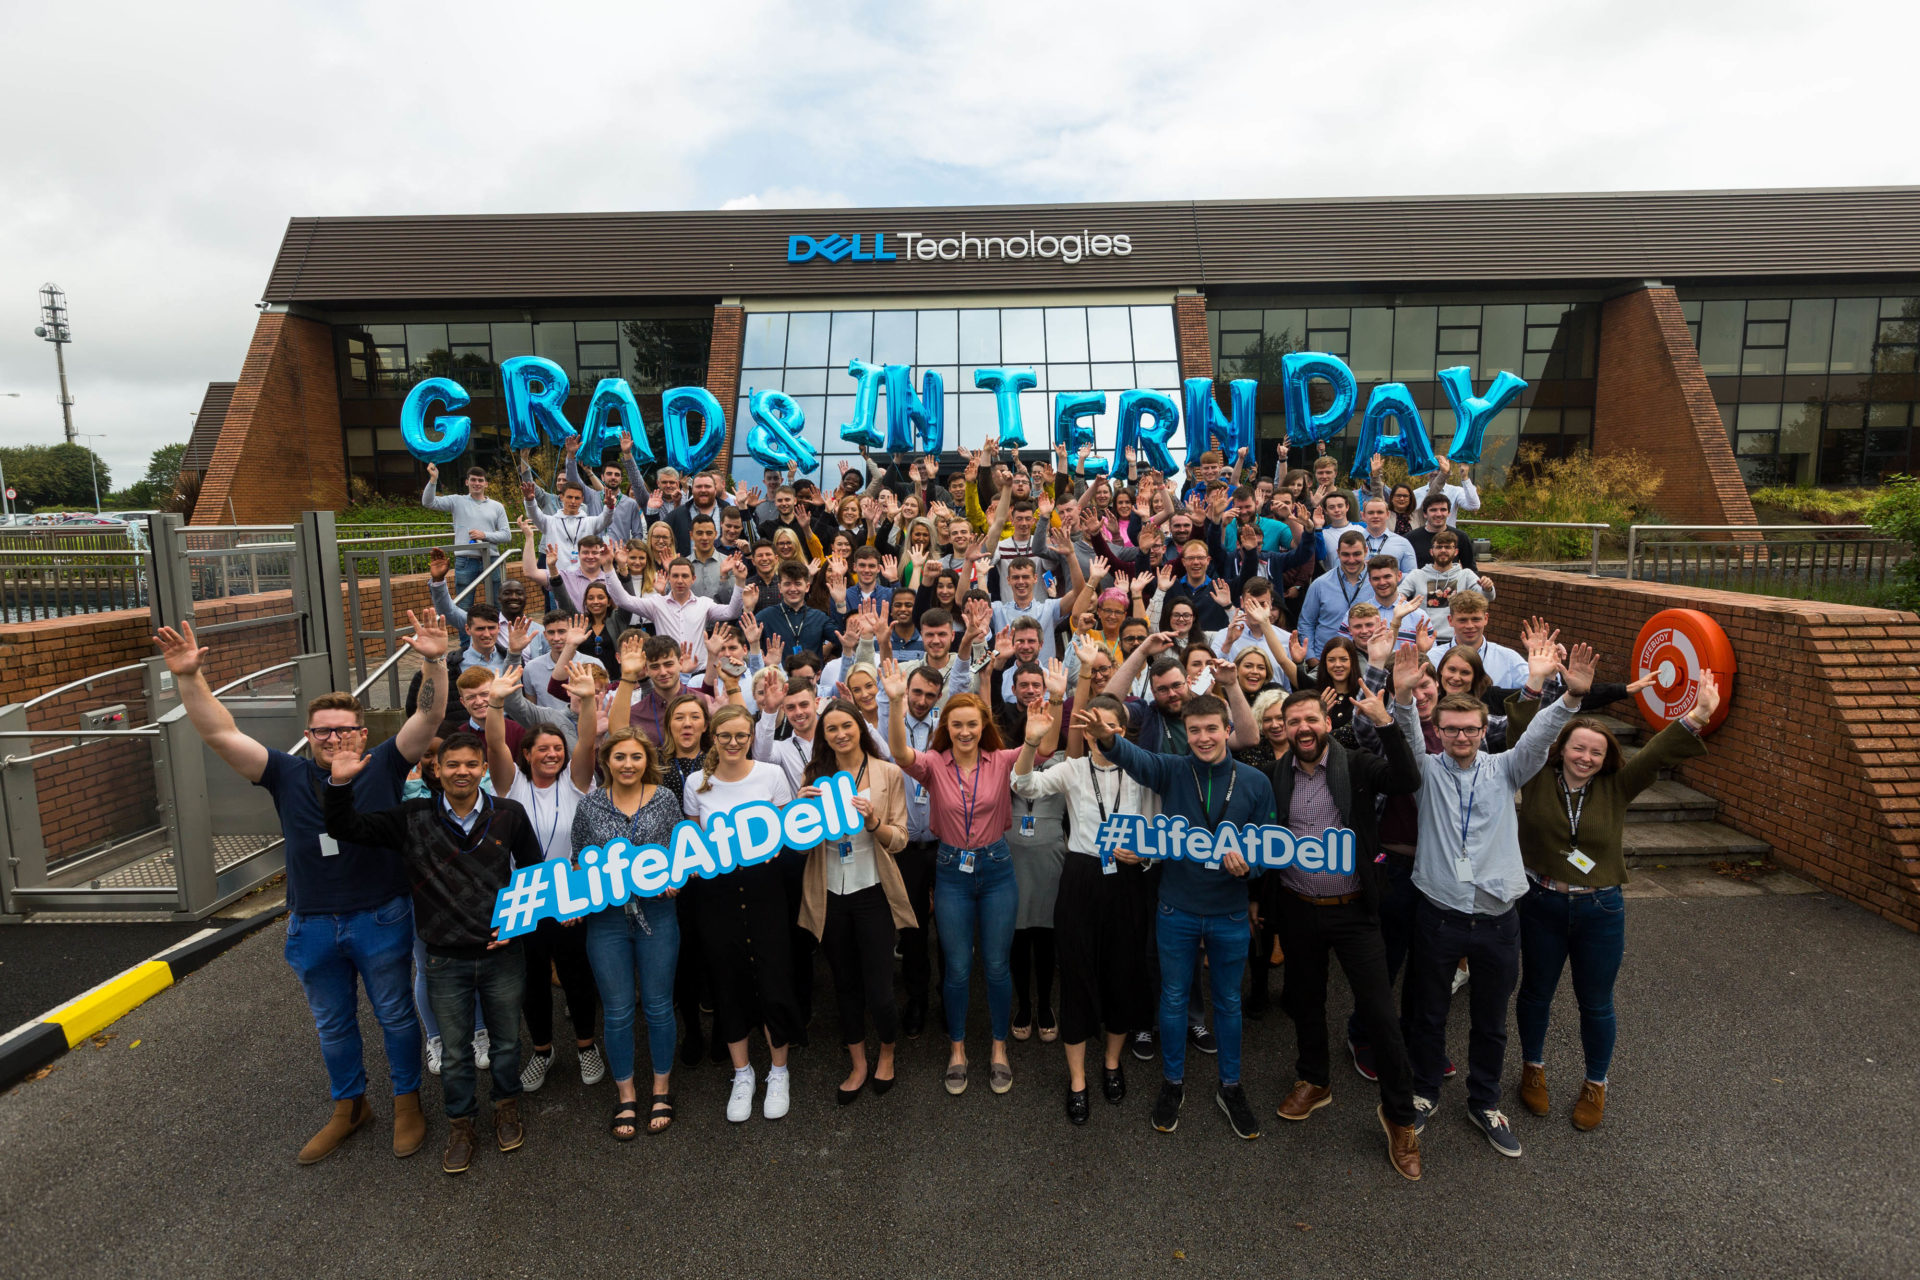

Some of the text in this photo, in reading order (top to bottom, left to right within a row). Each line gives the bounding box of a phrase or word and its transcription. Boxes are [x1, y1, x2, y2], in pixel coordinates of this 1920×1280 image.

[787, 229, 1133, 264] DELL Technologies
[400, 351, 1529, 480] GRAD & INTERN DAY
[1643, 632, 1669, 664] LIFEBUOY
[1668, 685, 1697, 716] LIFEBUOY
[498, 775, 861, 931] #LifeAtDell
[1100, 817, 1352, 873] #LifeAtDell
